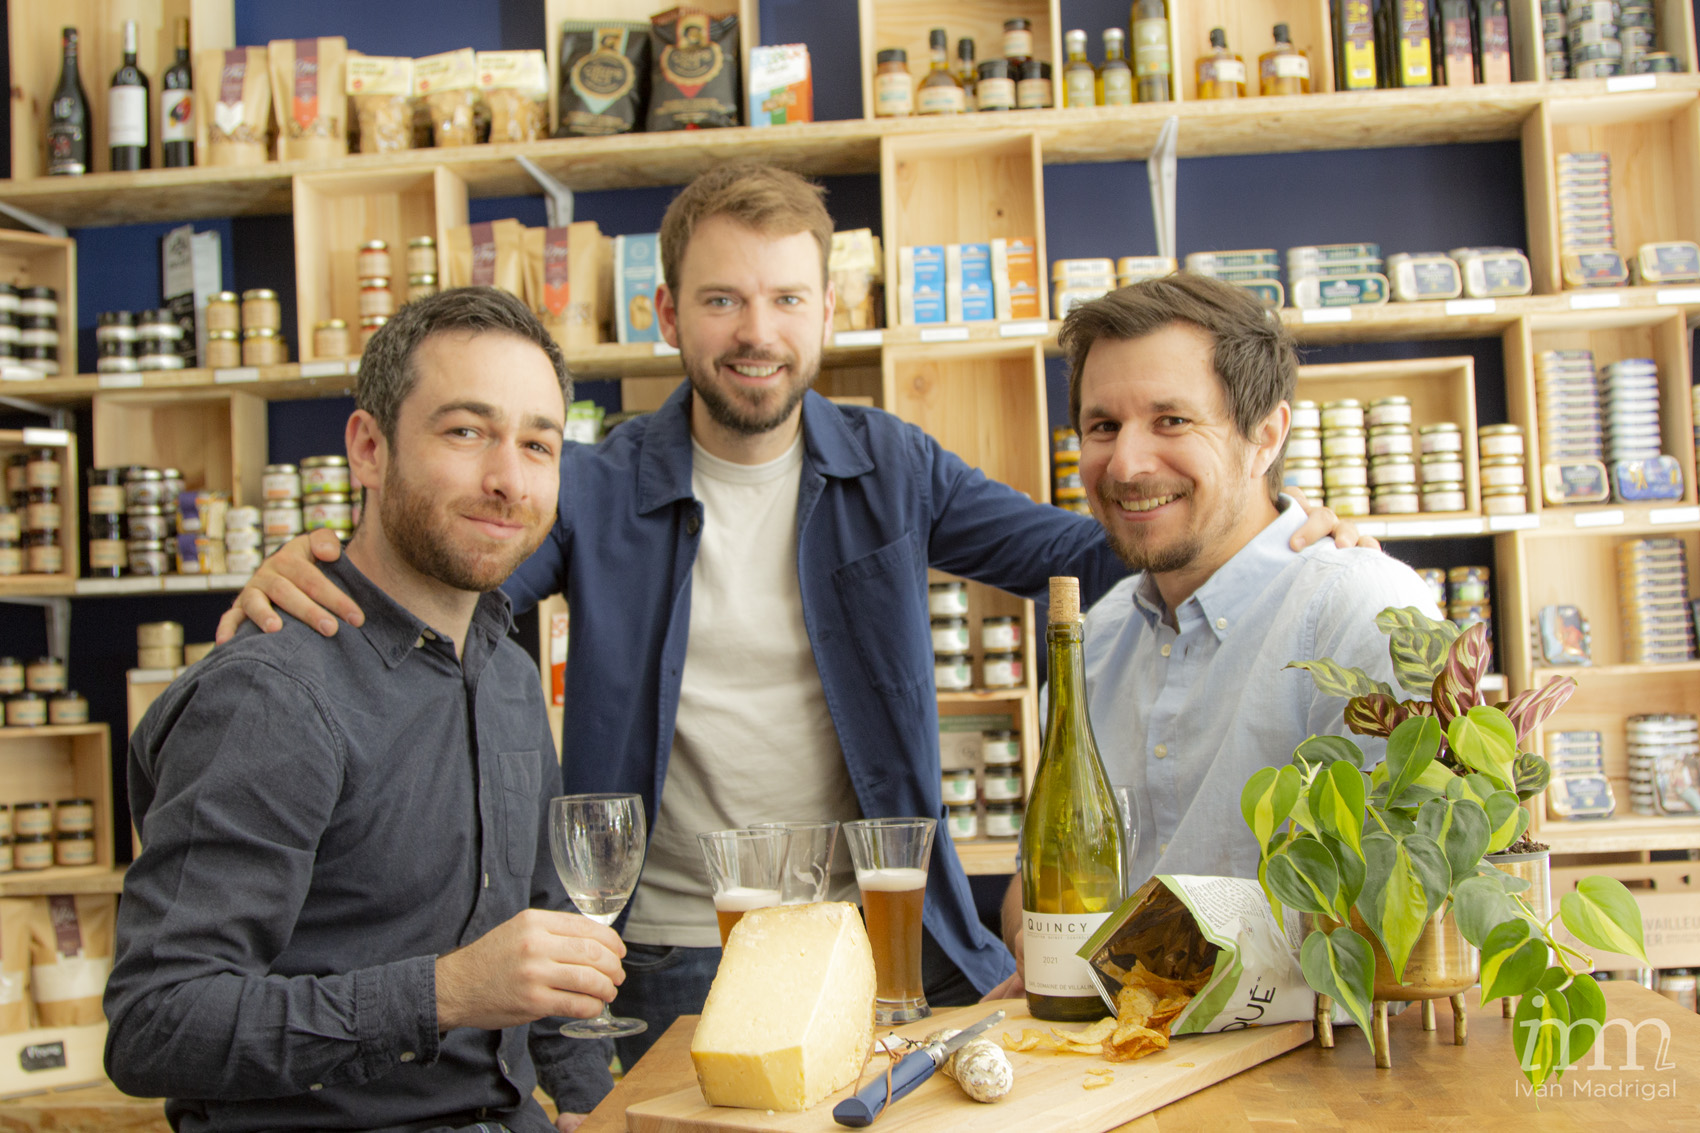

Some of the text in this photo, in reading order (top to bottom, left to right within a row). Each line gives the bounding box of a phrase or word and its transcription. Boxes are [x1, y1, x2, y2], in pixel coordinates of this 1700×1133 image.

[1028, 918, 1087, 932] QUINCY
[1643, 916, 1700, 931] VAILLEU
[1042, 956, 1058, 964] 2021
[1059, 983, 1067, 991] DE
